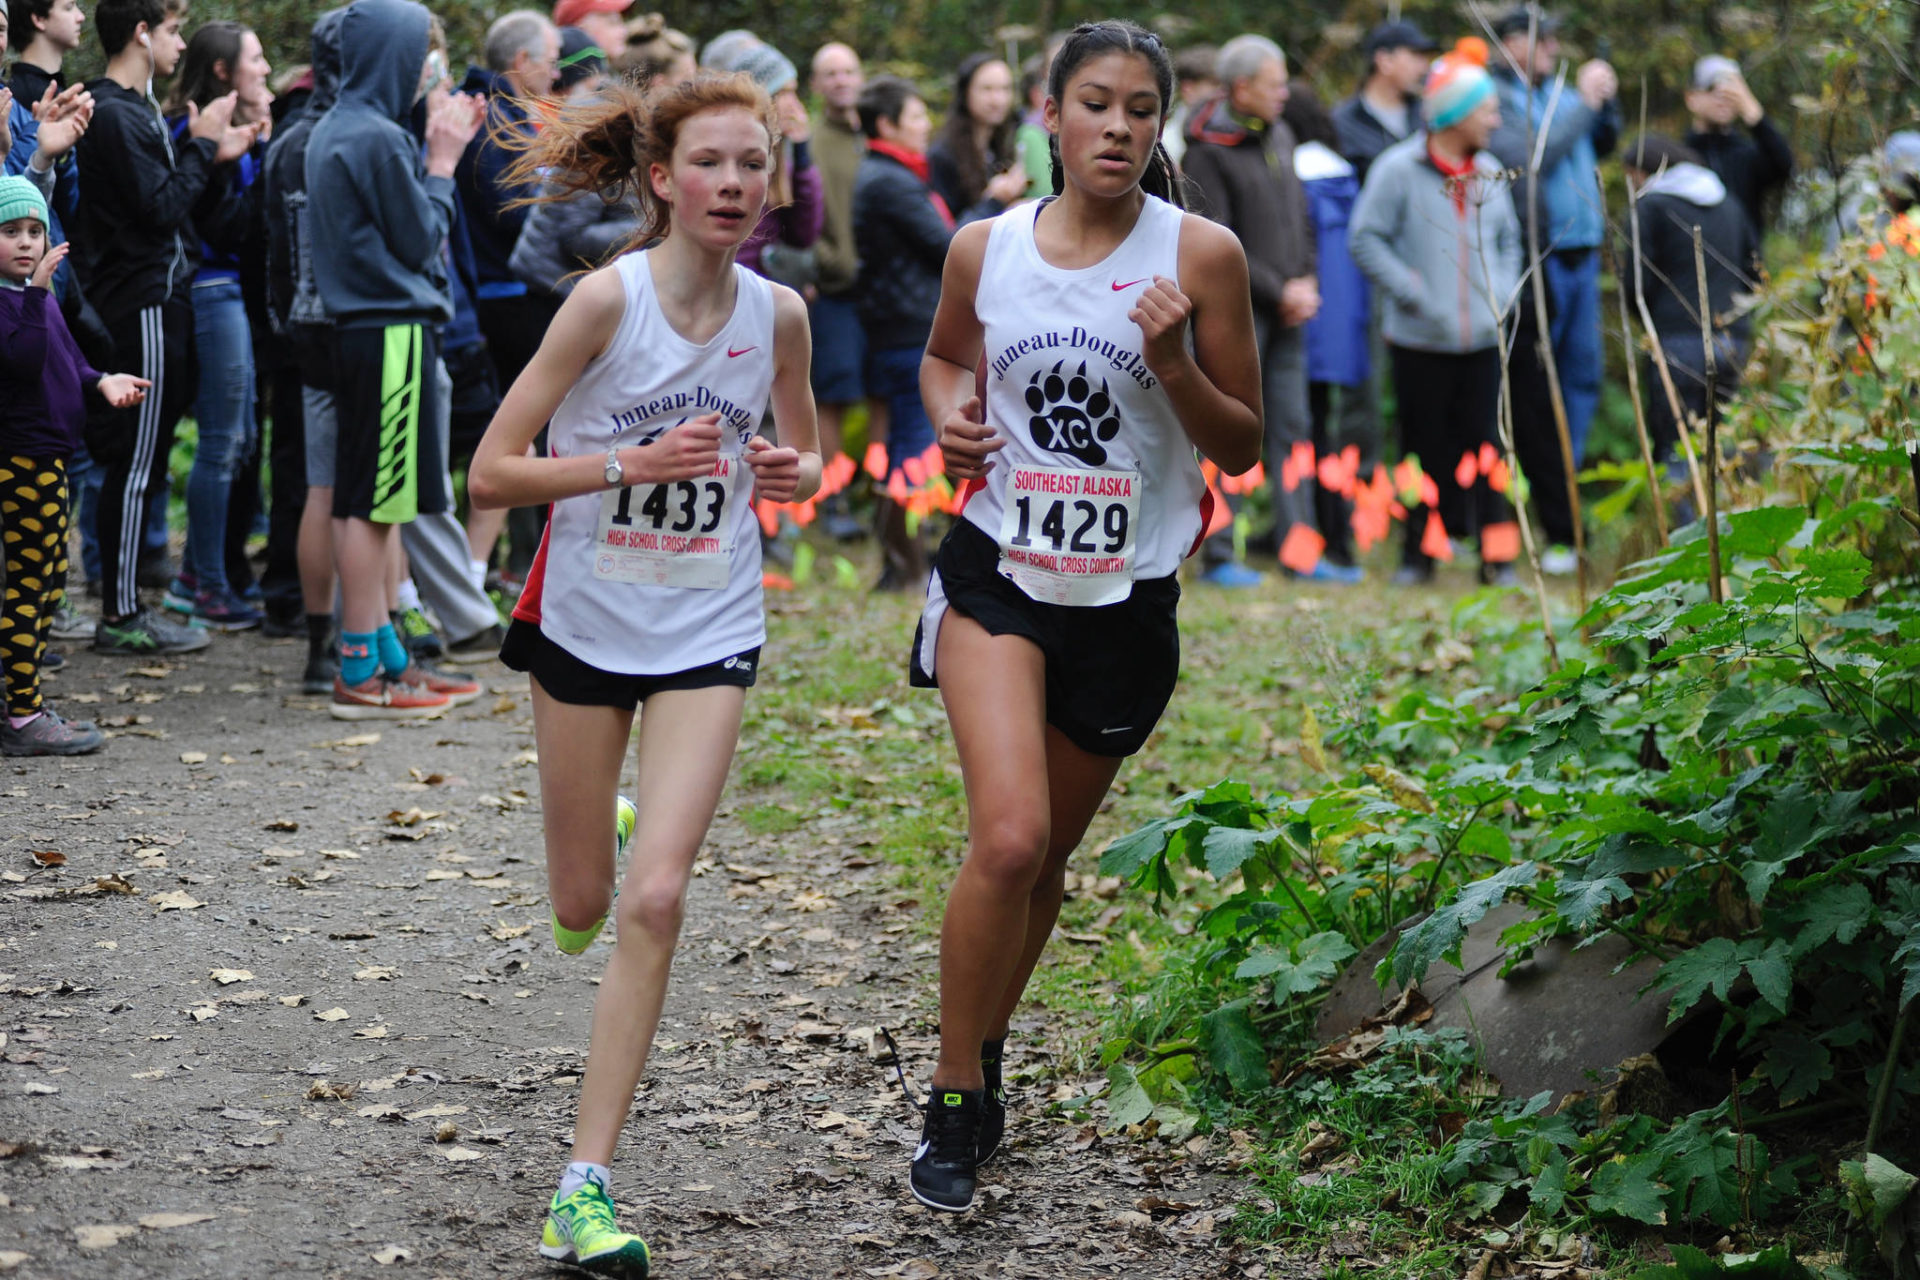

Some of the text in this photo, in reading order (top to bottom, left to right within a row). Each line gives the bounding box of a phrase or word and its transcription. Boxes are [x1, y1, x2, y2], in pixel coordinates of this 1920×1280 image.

[990, 326, 1156, 390] Juneau-Douglas
[610, 385, 753, 445] Juneau-Douglas
[1046, 418, 1088, 449] XC
[1014, 469, 1131, 497] SOUTHEAST ALASKA
[611, 480, 726, 533] 1433
[1010, 496, 1129, 553] 1429
[607, 529, 627, 547] HIGH
[628, 531, 659, 550] SCHOOL
[661, 534, 687, 553] CROSS
[1008, 549, 1125, 574] HIGH SCHOOL CROSS COUNTRY
